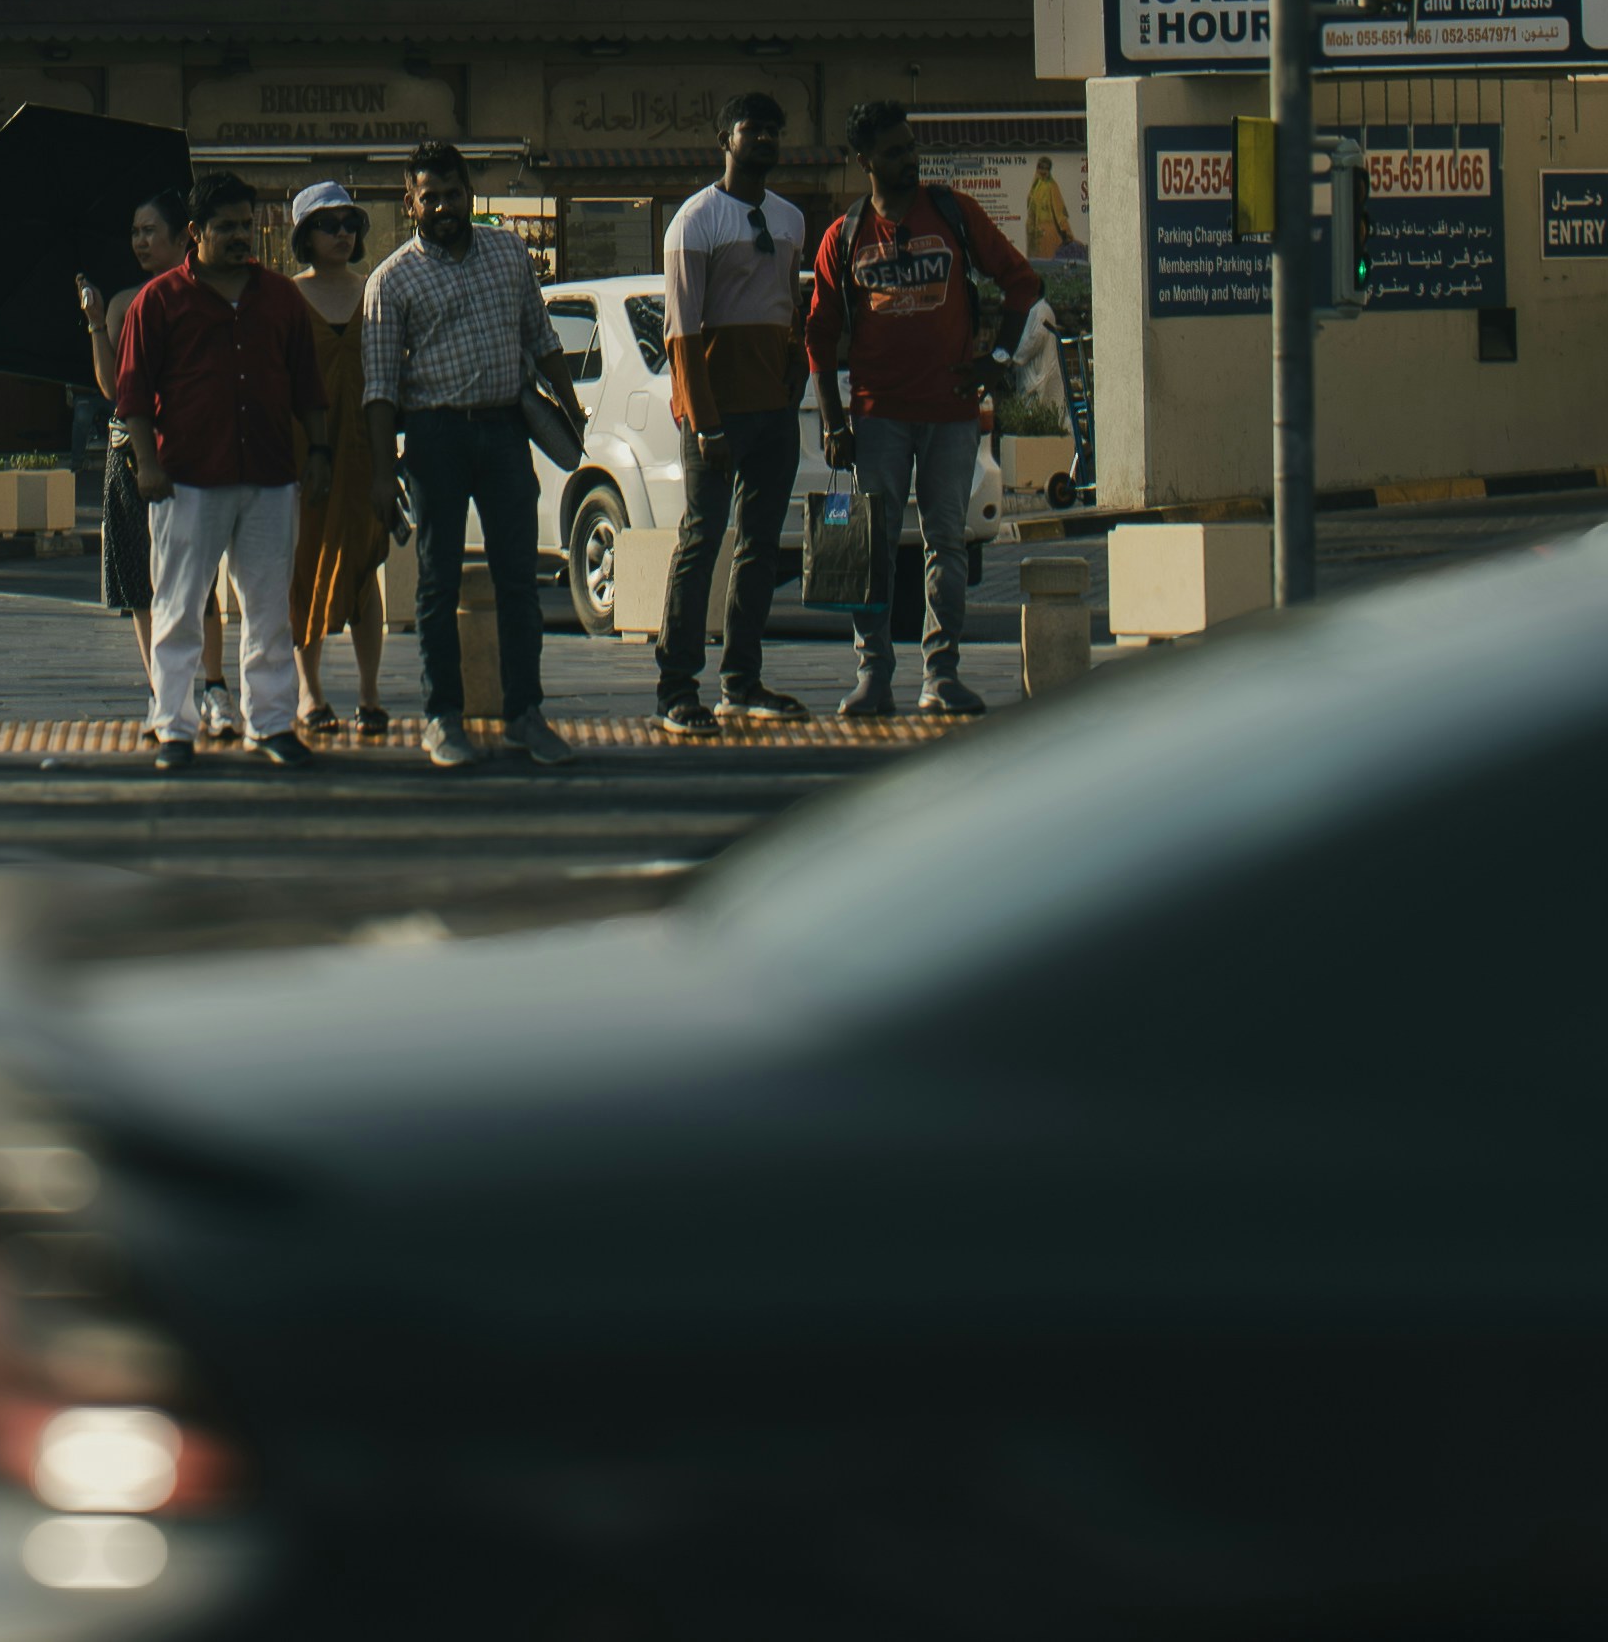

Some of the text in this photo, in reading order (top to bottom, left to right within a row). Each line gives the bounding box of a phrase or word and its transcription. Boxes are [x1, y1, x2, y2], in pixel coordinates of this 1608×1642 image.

[1140, 13, 1151, 44] PER
[1326, 30, 1354, 47] Mob:
[1442, 25, 1516, 43] 052-5547971
[260, 84, 387, 114] BRIGHTON
[217, 121, 429, 141] GENERAL TRADING
[988, 156, 1012, 165] THAN
[1014, 156, 1027, 164] 176
[963, 178, 1002, 189] SAFFRON
[1551, 189, 1603, 211] دخول
[1158, 226, 1193, 247] Parking
[1548, 219, 1607, 245] ENTRY
[1159, 256, 1214, 276] Membership
[1217, 256, 1252, 276] Parking
[1407, 250, 1443, 269] لدينا
[1448, 247, 1493, 269] متوفر
[860, 257, 945, 289] DENIM
[1159, 290, 1170, 302] on
[1173, 284, 1208, 306] Monthly
[1211, 284, 1228, 301] and
[1231, 283, 1260, 304] Yearly
[1415, 283, 1426, 297] و
[1430, 275, 1483, 300] شهري
